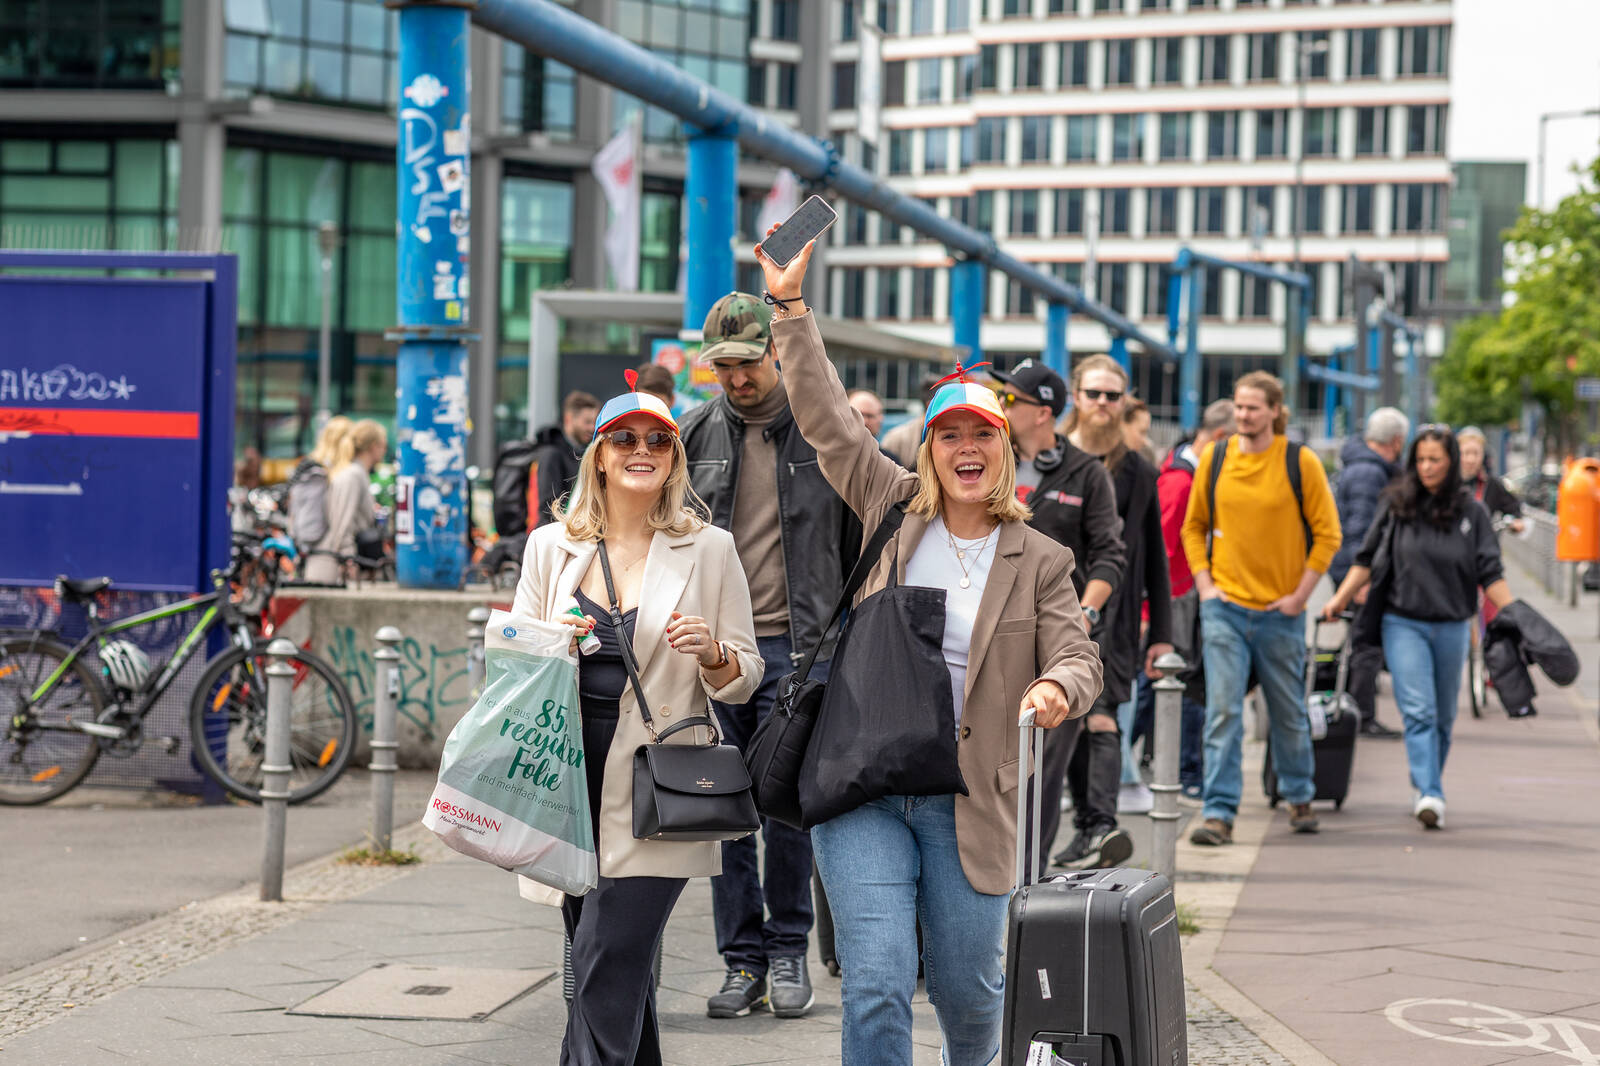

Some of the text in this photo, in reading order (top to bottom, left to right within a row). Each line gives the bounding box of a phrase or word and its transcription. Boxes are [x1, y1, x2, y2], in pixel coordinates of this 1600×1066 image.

[513, 708, 531, 720] aus
[507, 746, 561, 791] Folie
[477, 773, 497, 786] und
[497, 781, 539, 803] mehrfach
[432, 798, 502, 833] ROSSMANN
